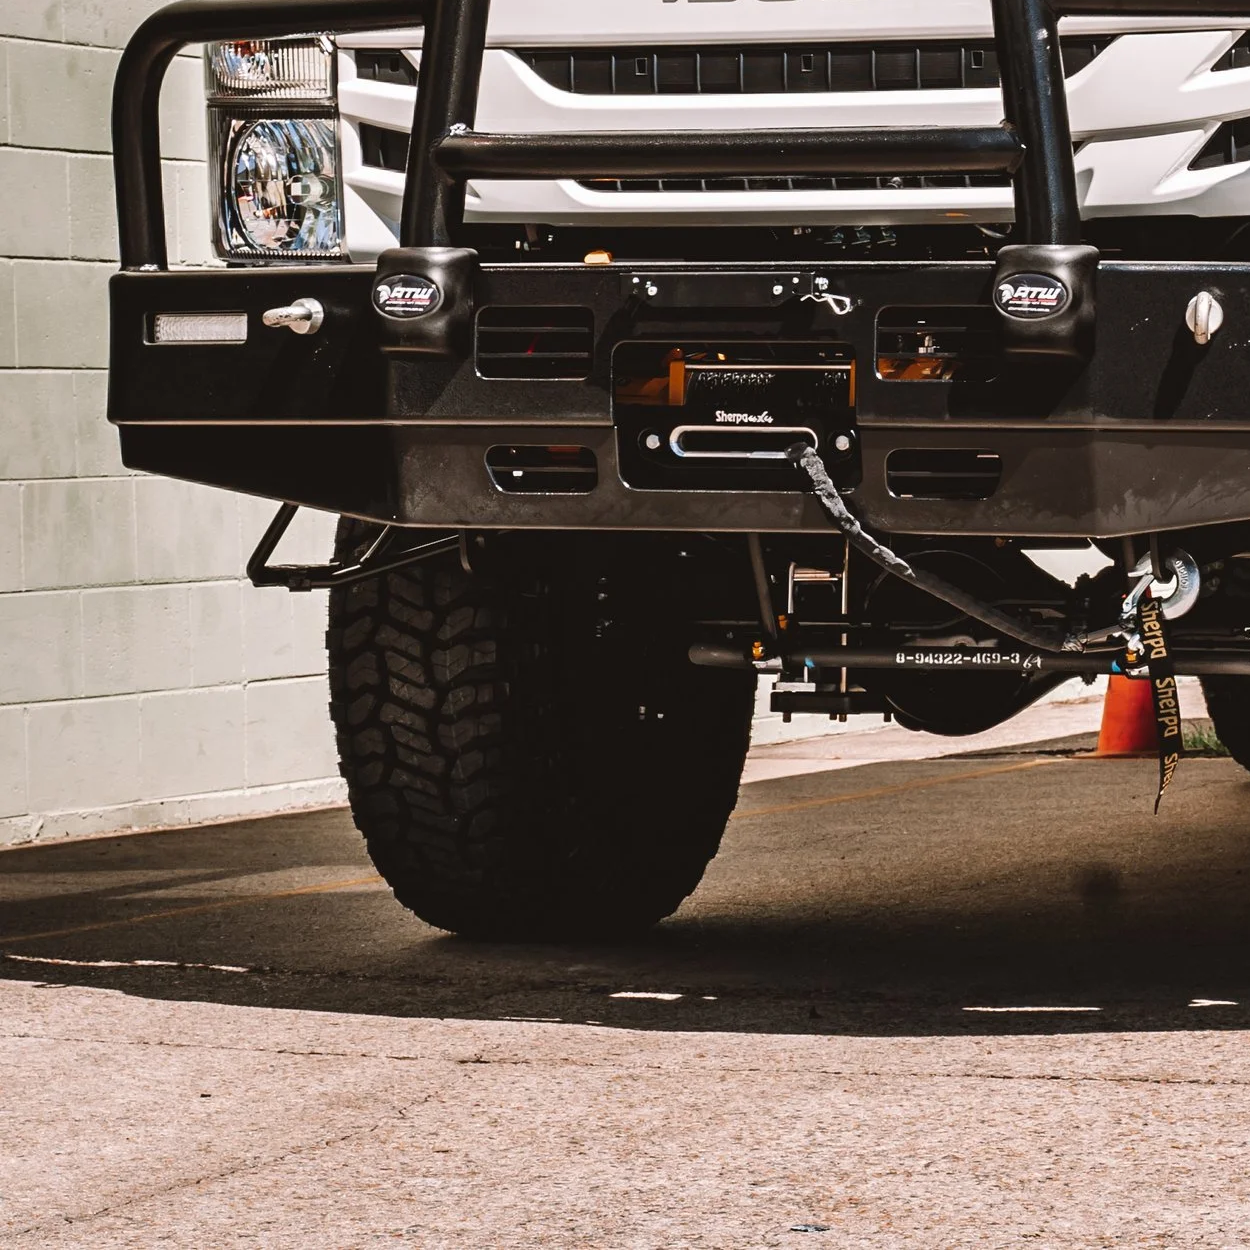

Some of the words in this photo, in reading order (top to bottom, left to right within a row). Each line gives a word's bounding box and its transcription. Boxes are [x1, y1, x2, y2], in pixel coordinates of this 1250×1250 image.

[389, 286, 435, 300] ATW
[1013, 286, 1061, 300] ATW
[1141, 600, 1168, 659] Sherpa
[1155, 677, 1179, 738] Sherpa
